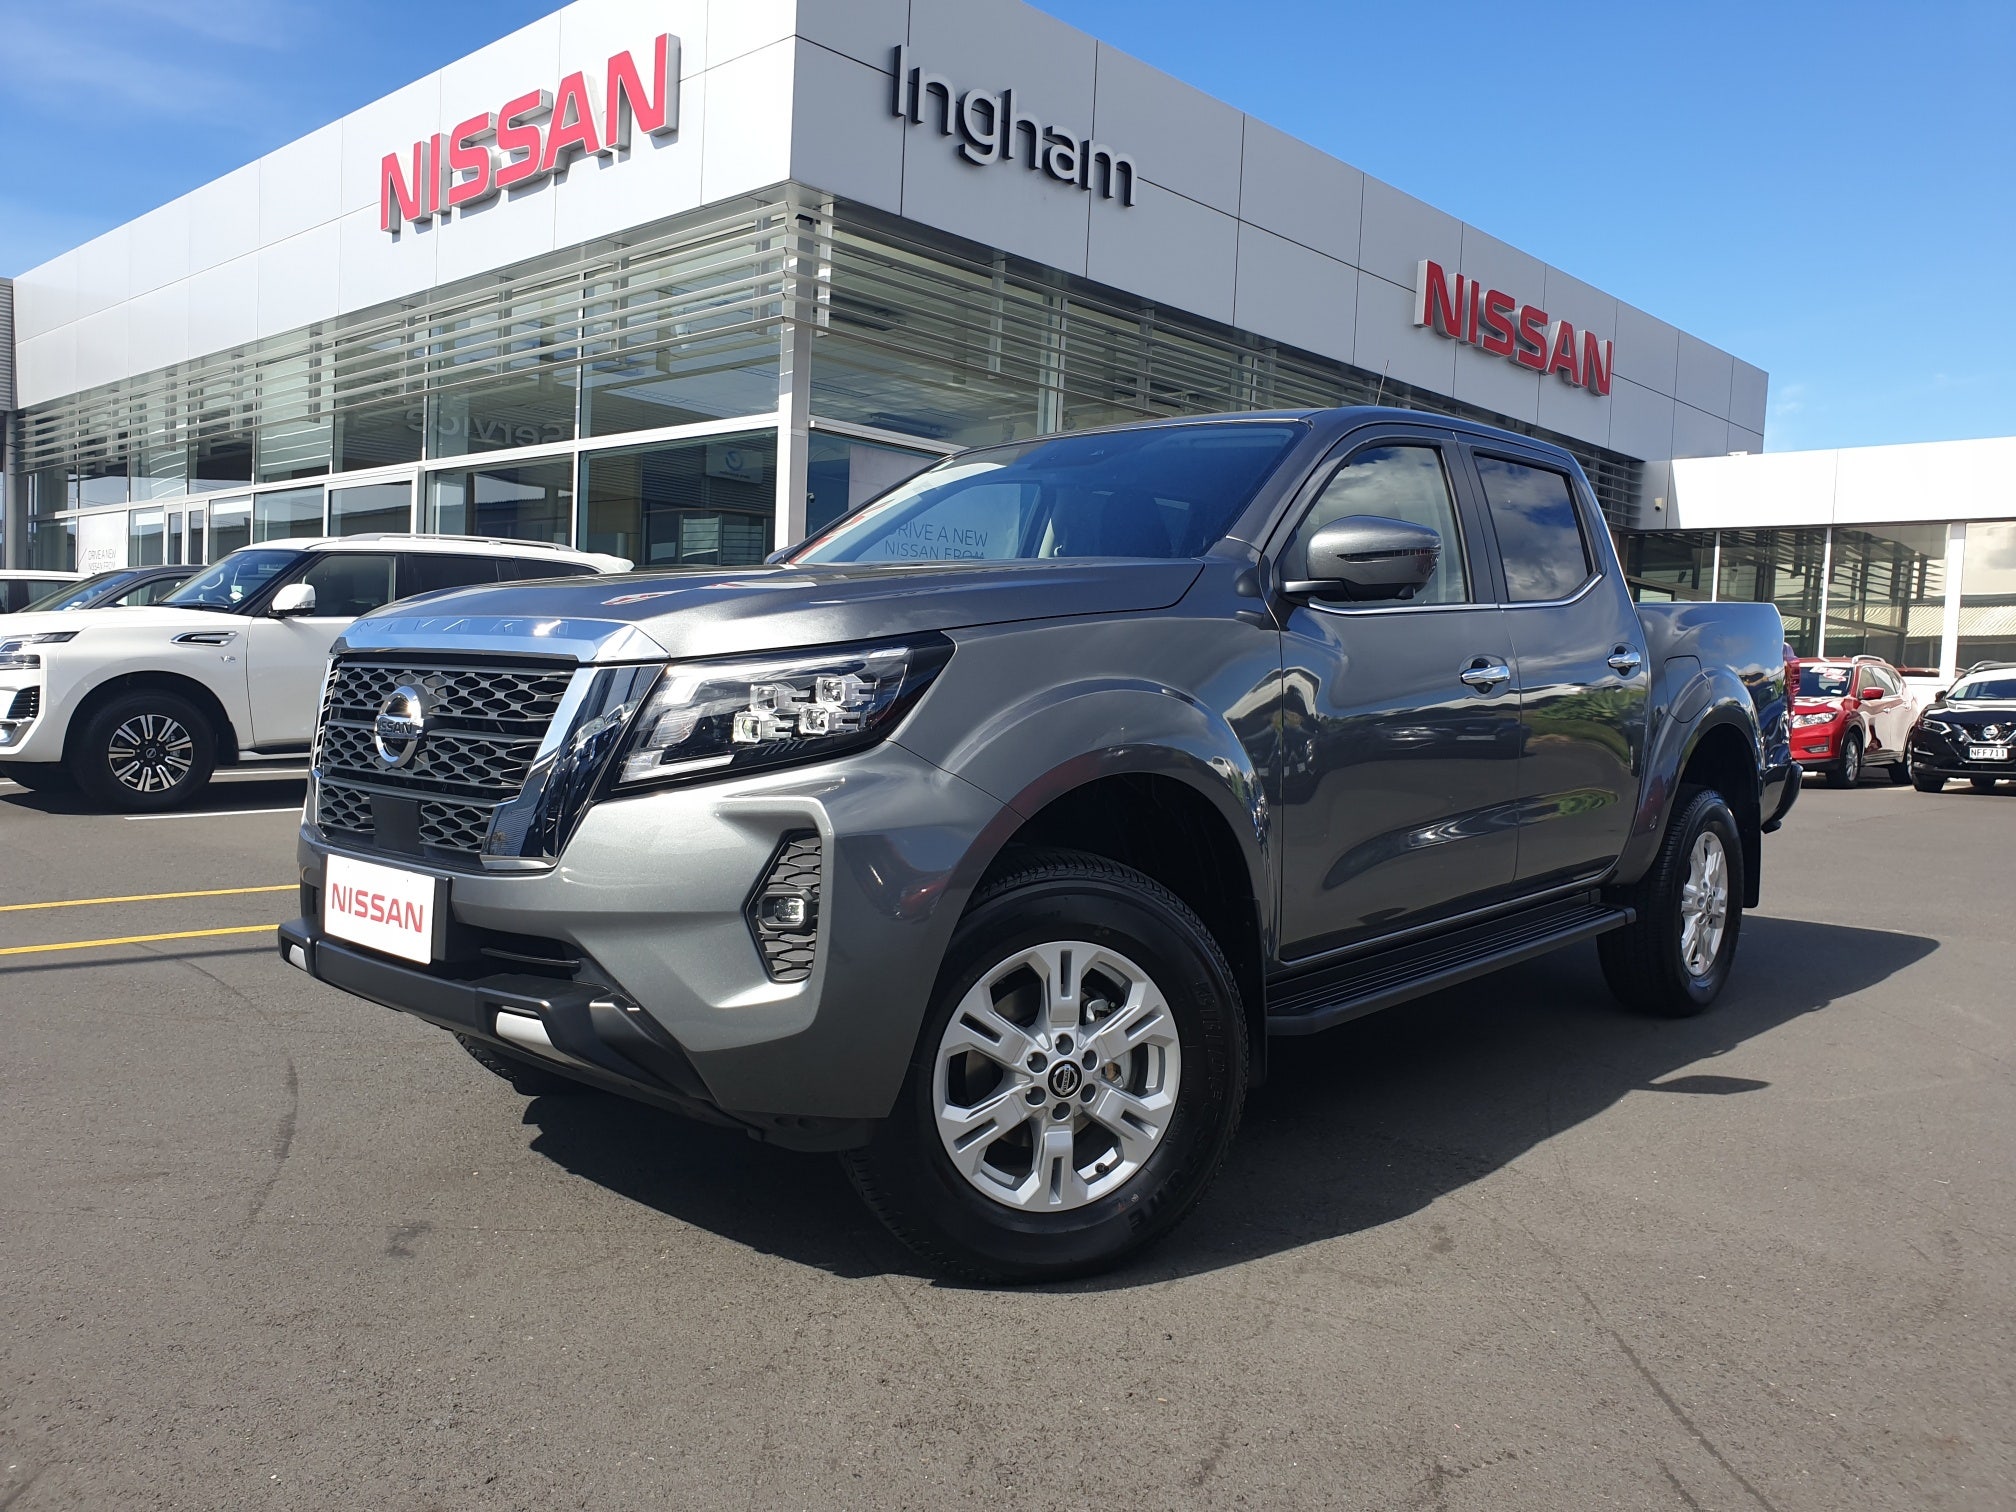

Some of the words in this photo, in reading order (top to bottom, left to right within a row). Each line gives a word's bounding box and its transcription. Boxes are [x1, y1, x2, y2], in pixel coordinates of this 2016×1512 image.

[380, 32, 681, 232] NISSAN
[893, 45, 1137, 207] Ingham
[1415, 258, 1614, 396] NISSAN
[884, 540, 939, 560] NISSAN
[896, 521, 933, 541] RIVE
[937, 526, 949, 543] A
[953, 528, 988, 548] NEW
[331, 882, 424, 934] NISSAN
